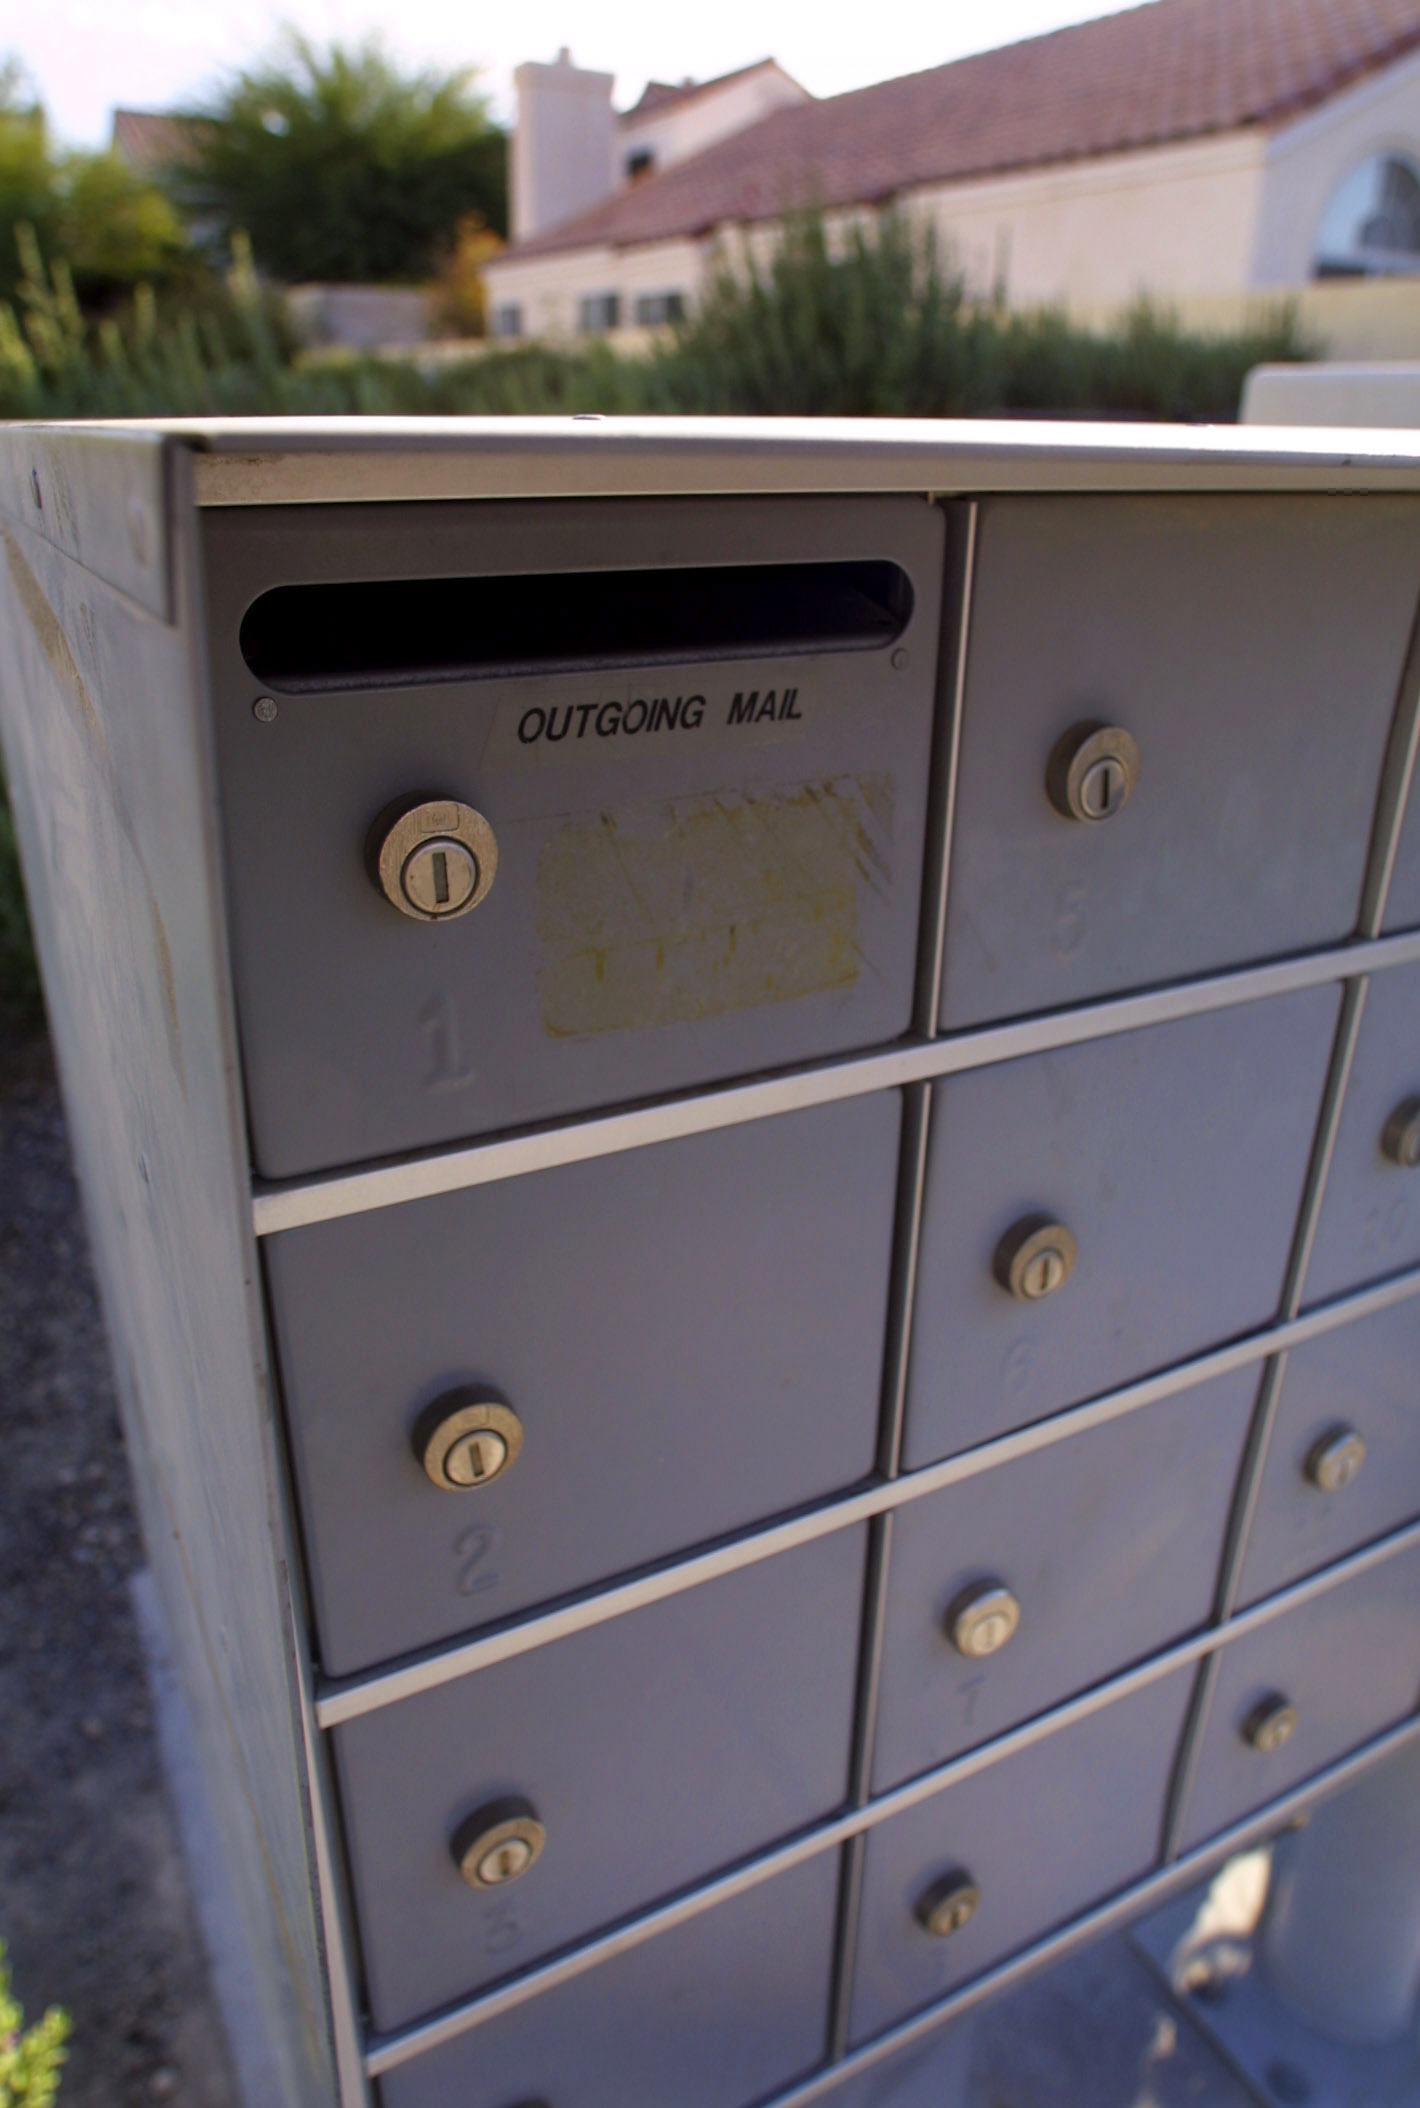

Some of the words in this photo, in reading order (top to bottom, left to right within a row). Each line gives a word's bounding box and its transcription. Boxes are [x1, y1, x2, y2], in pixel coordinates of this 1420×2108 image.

[517, 694, 706, 744] OUTGOING
[727, 688, 802, 725] MAIL
[1051, 881, 1090, 958] 5
[416, 988, 476, 1095] 1
[452, 1523, 504, 1597] 2
